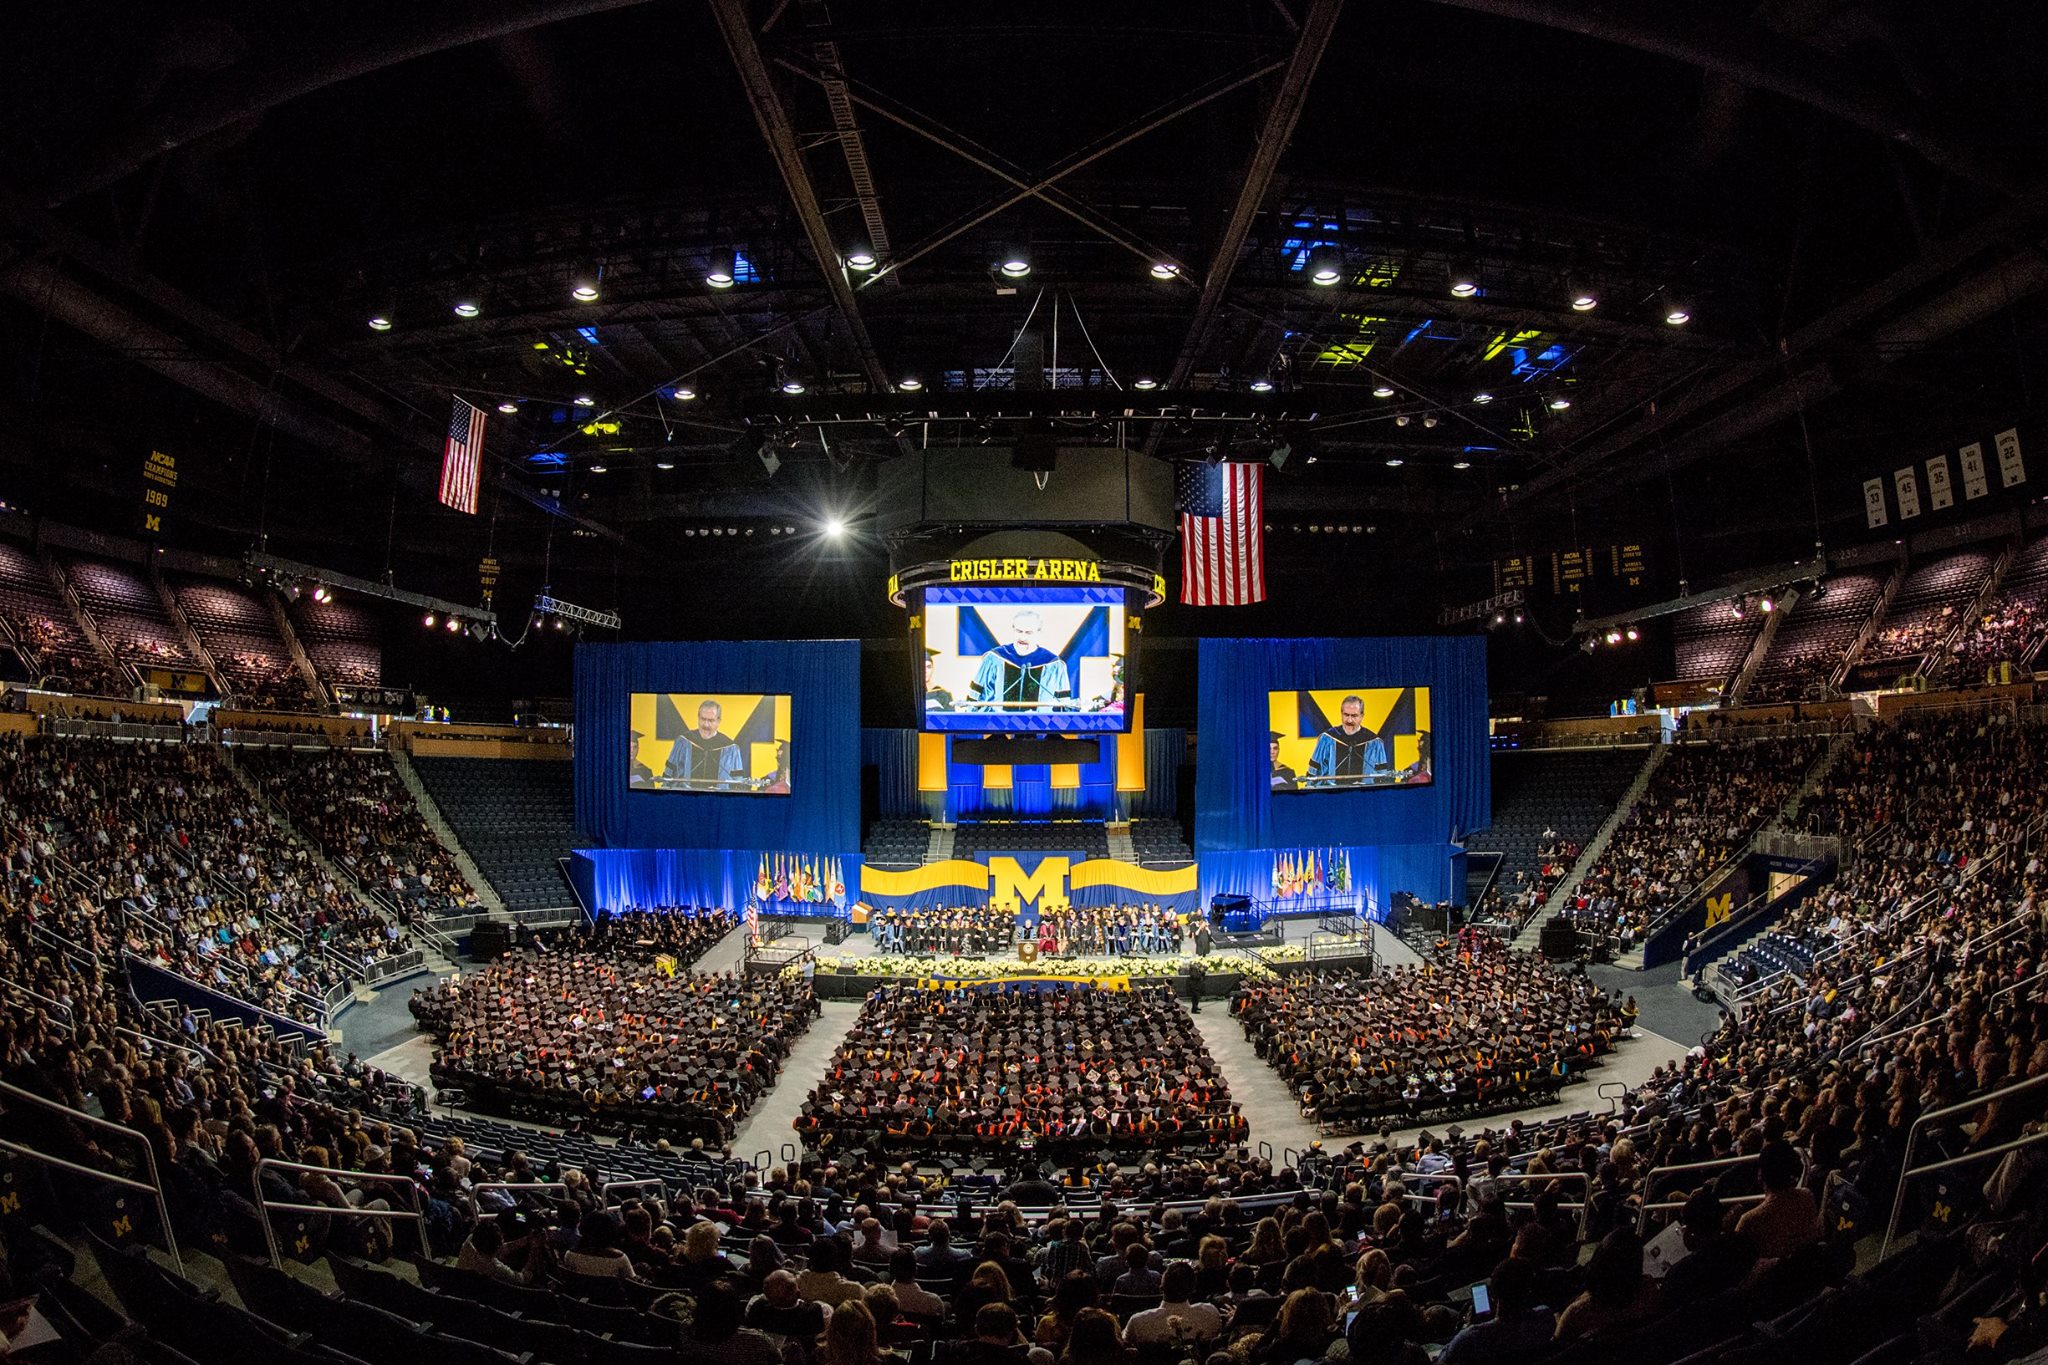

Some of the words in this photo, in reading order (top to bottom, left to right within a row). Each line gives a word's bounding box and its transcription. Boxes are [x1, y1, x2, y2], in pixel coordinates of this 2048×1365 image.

[150, 450, 175, 469] NCAA
[2003, 446, 2015, 459] 22
[144, 460, 178, 481] CHAMPIONS
[1967, 460, 1977, 472] 41
[1934, 471, 1944, 484] 35
[1902, 482, 1912, 494] 45
[145, 488, 168, 508] 1989
[1870, 493, 1880, 504] 33
[145, 513, 161, 532] M
[951, 558, 1028, 581] CRISLER
[1035, 558, 1100, 581] ARENA
[481, 577, 496, 585] 2017
[1569, 584, 1580, 593] M
[1628, 577, 1640, 586] M
[909, 615, 922, 629] M
[1127, 615, 1141, 630] M
[988, 856, 1070, 915] M
[1705, 891, 1732, 928] M
[1932, 1200, 1952, 1224] M
[111, 1214, 133, 1238] M
[295, 1234, 310, 1254] M
